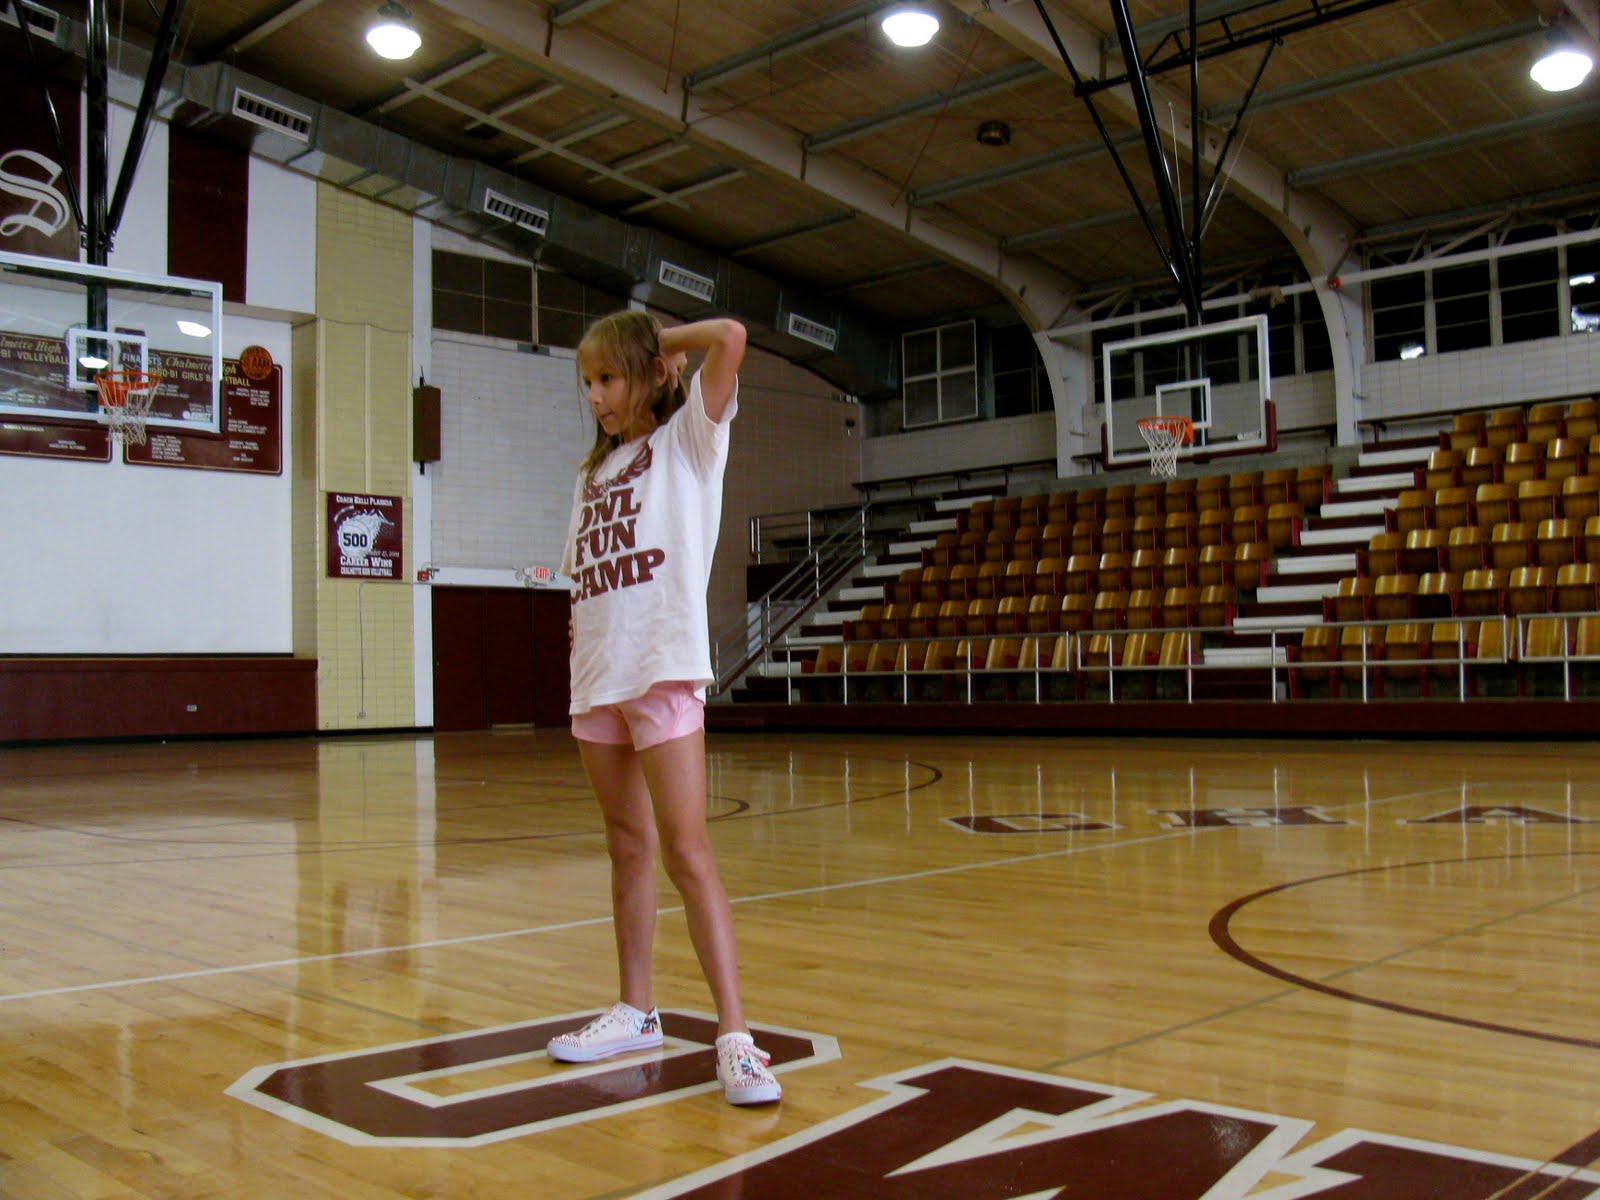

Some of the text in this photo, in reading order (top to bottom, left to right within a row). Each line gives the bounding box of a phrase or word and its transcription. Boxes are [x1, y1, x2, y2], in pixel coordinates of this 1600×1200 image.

[17, 350, 69, 366] VOLLEYBALL
[343, 533, 368, 547] 500
[575, 518, 637, 567] FUN
